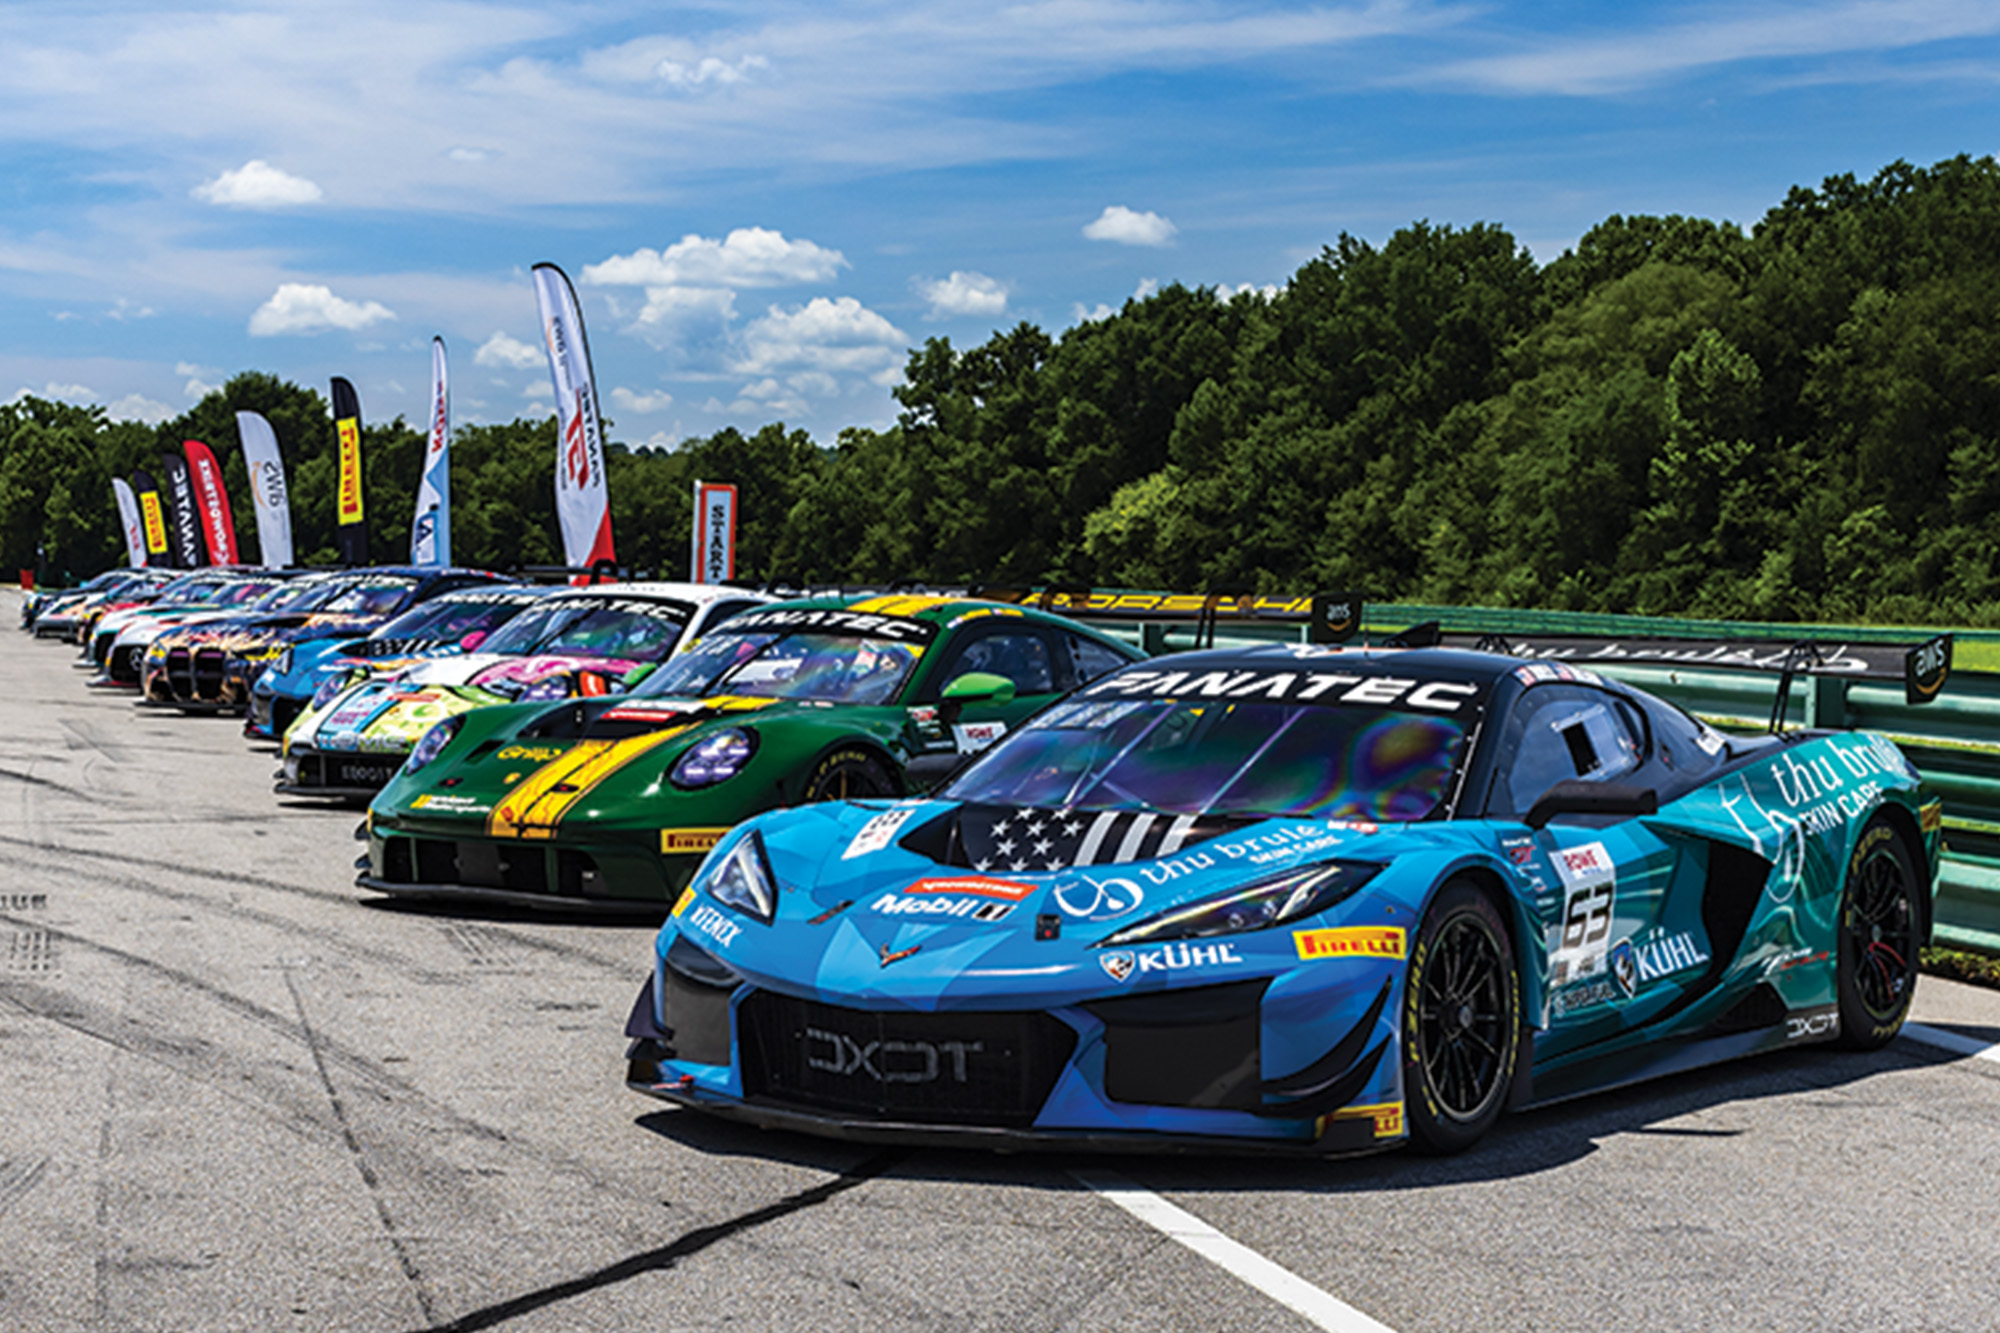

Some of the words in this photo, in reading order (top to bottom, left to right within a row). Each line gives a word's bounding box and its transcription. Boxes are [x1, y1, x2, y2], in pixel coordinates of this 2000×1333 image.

[711, 505, 725, 579] START
[1085, 671, 1479, 711] FANATEC
[1770, 752, 1844, 807] thu
[1140, 854, 1215, 884] thu
[1214, 824, 1324, 858] brule
[870, 894, 979, 917] Mobil
[1562, 881, 1614, 949] 63
[1140, 942, 1243, 973] KÜHL
[1302, 931, 1400, 955] PIRELLI
[1635, 926, 1709, 981] KÜHL
